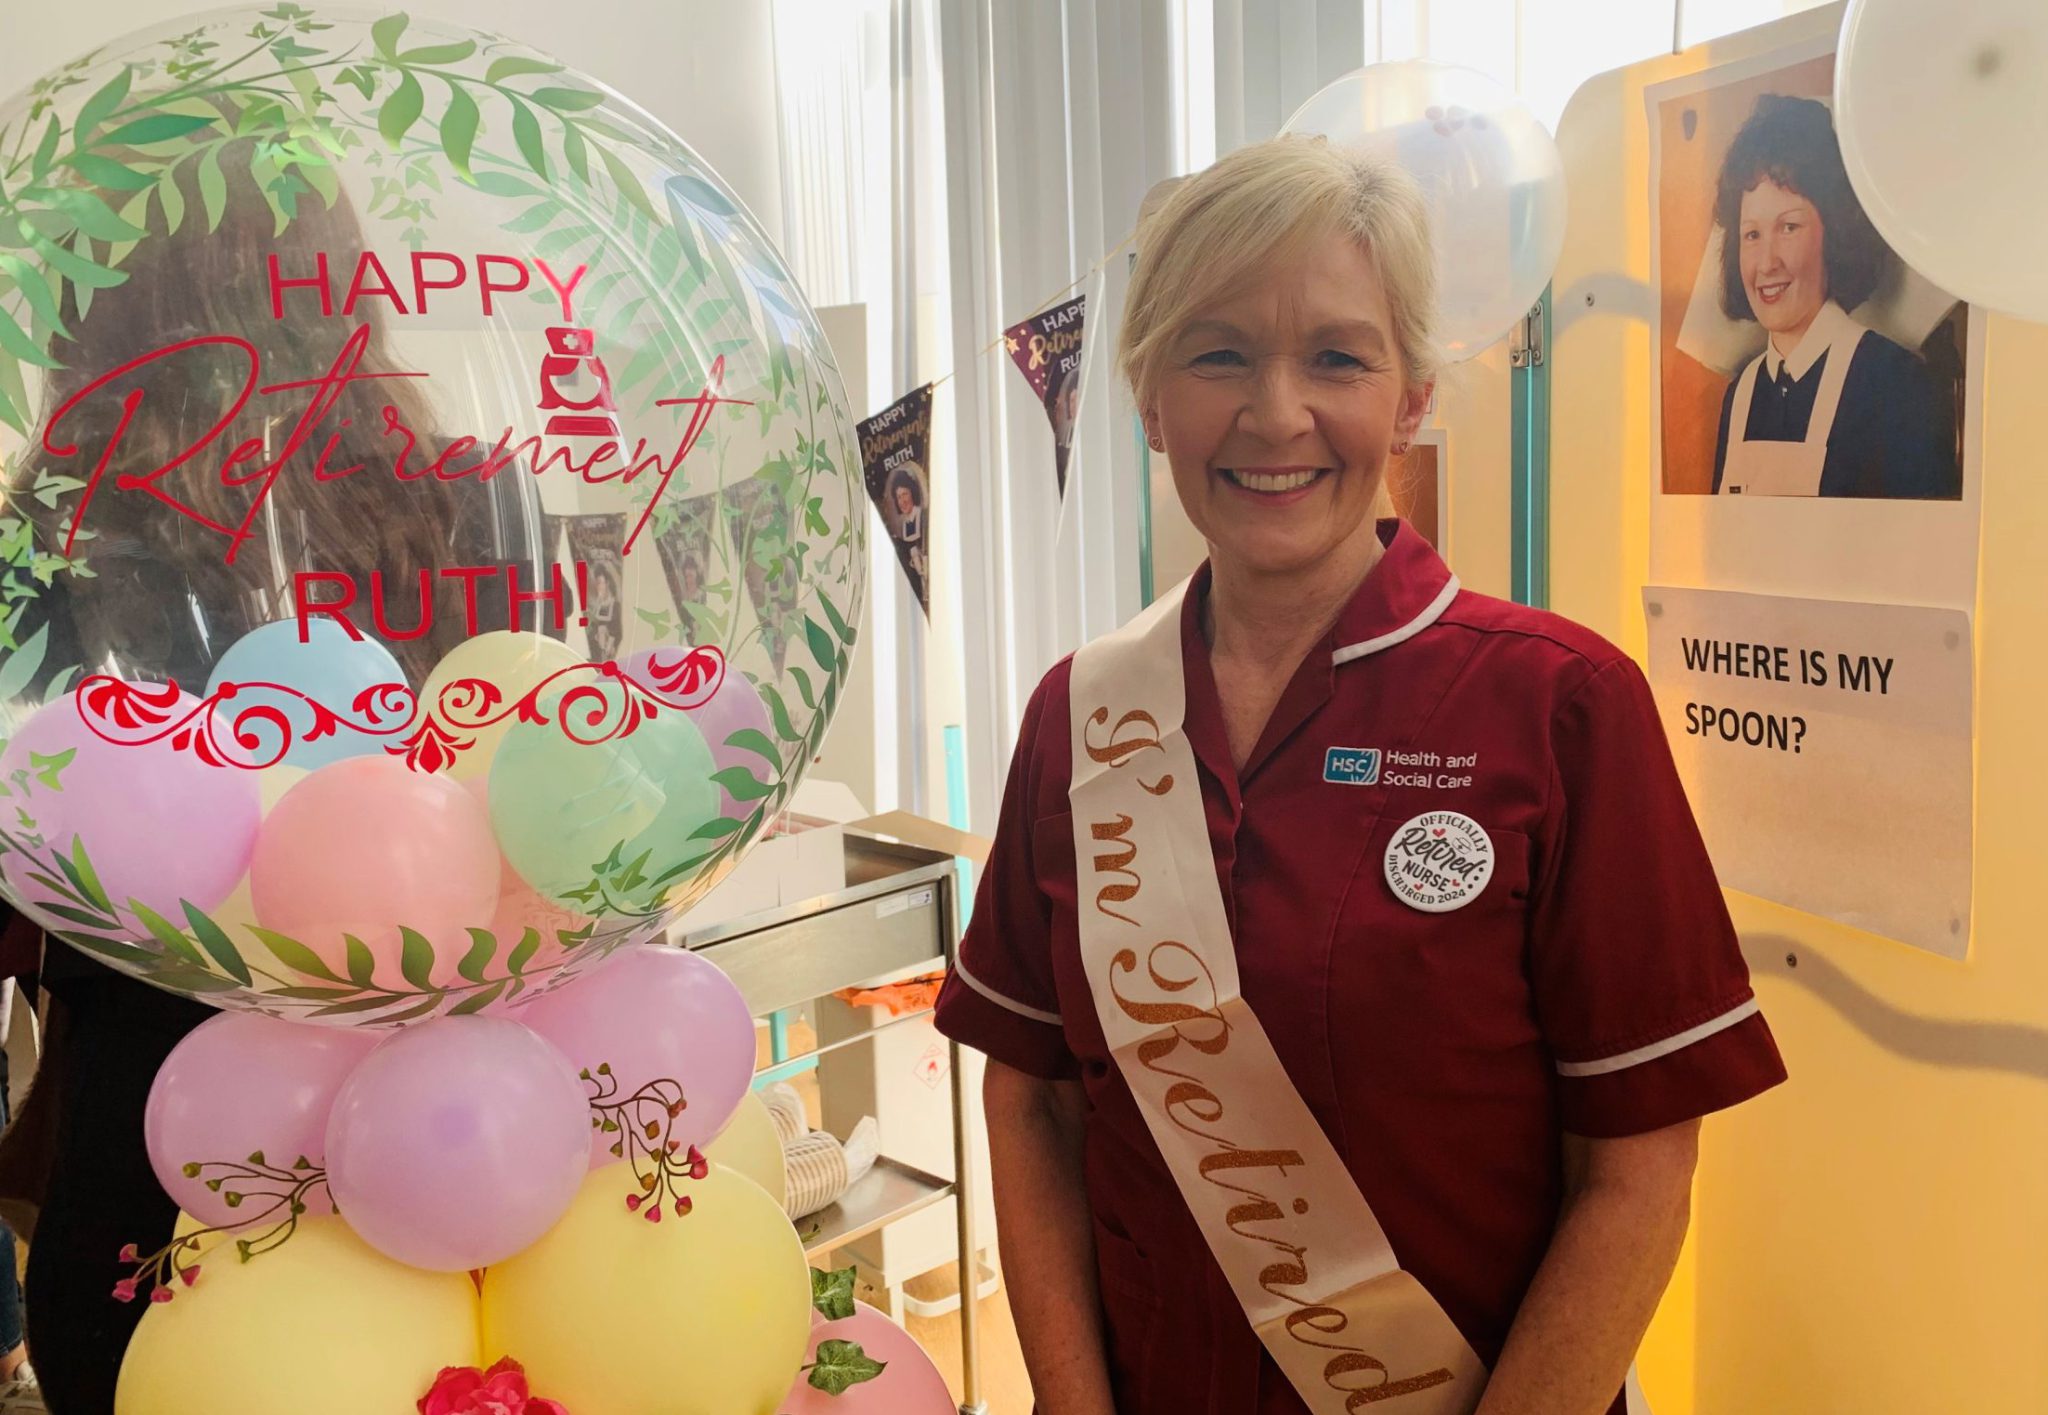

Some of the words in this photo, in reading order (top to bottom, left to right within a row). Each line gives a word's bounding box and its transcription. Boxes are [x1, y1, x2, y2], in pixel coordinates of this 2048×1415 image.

[268, 250, 588, 322] HAPPY
[1060, 350, 1082, 373] RU
[868, 403, 906, 435] HAPPY
[42, 322, 756, 566] Retirement
[883, 444, 914, 471] RUTH
[294, 560, 590, 643] RUTH!
[1681, 637, 1790, 682] WHERE
[1800, 649, 1828, 686] IS
[1838, 653, 1894, 694] MY
[1685, 702, 1806, 753] SPOON?
[1332, 757, 1367, 773] HSC
[1383, 771, 1432, 788] Social
[1436, 774, 1472, 789] Care
[1386, 750, 1440, 767] Health
[1446, 753, 1477, 768] and
[1394, 827, 1487, 881] Retired
[1420, 815, 1488, 853] OFFICIALLY
[1389, 854, 1435, 904] DISCHARGED
[1437, 889, 1466, 903] 2024
[1402, 859, 1450, 892] NURSE
[1109, 940, 1455, 1415] Retired
